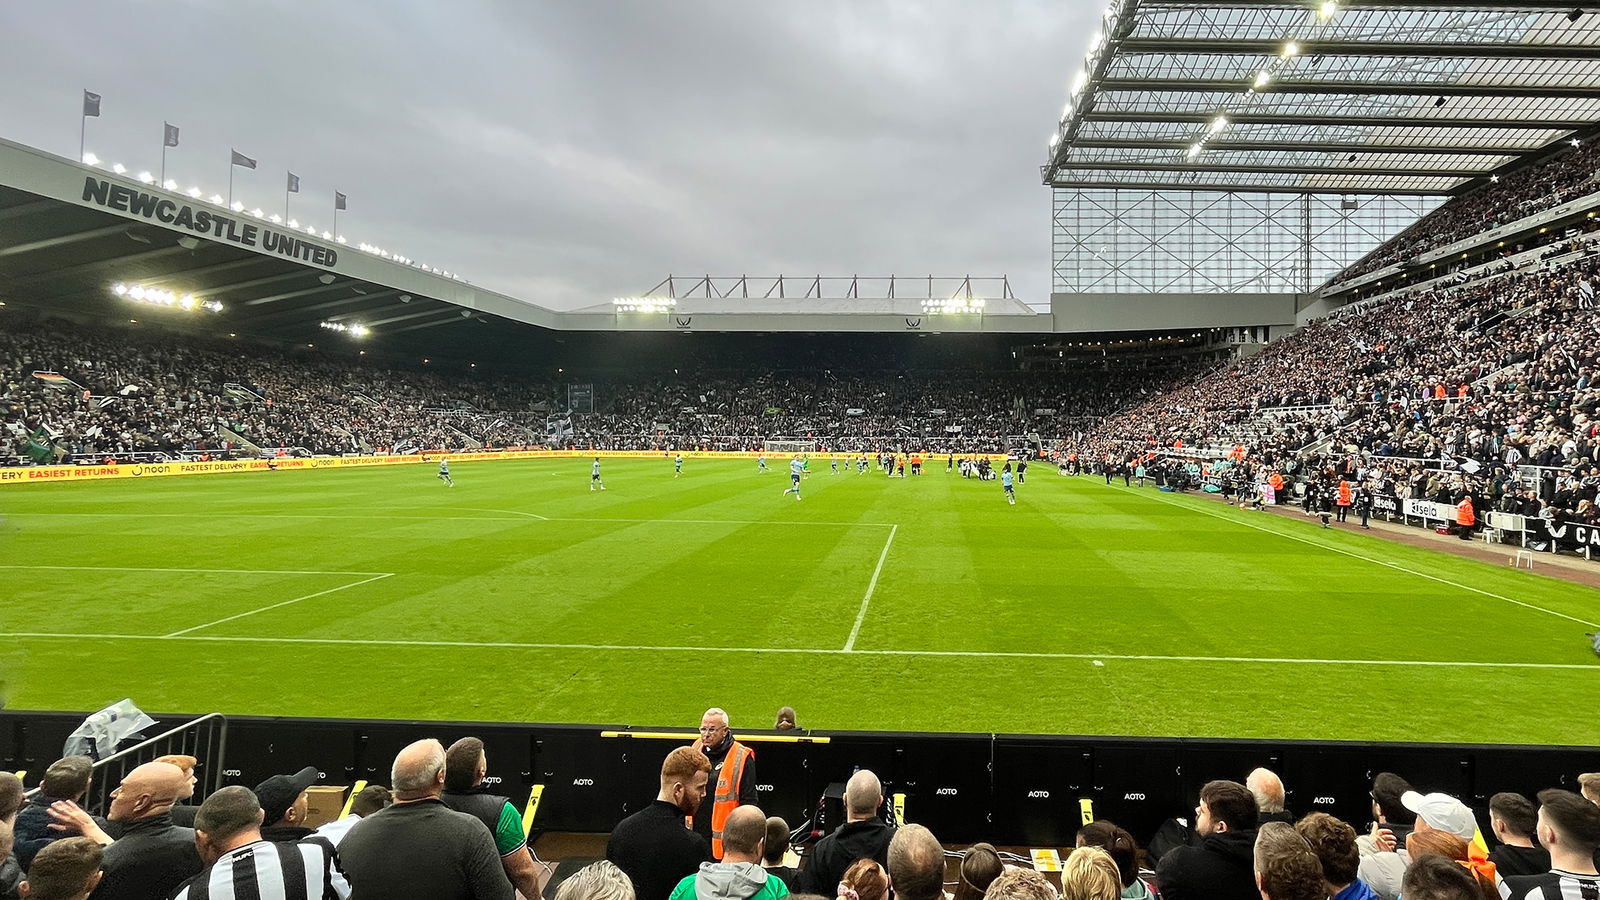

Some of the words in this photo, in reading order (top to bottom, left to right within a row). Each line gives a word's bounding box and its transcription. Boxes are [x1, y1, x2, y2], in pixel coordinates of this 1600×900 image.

[82, 176, 258, 246] NEWCASTLE
[262, 230, 338, 268] UNITED
[0, 471, 23, 480] ERY
[29, 469, 71, 478] EASIEST
[74, 467, 119, 476] RETURNS
[144, 465, 170, 473] noon
[181, 464, 213, 472] FASTEST
[1419, 505, 1437, 516] sela
[1576, 527, 1600, 545] CA
[481, 776, 502, 784] AOTO
[573, 778, 594, 786] AOTO
[1028, 790, 1049, 798] AOTO
